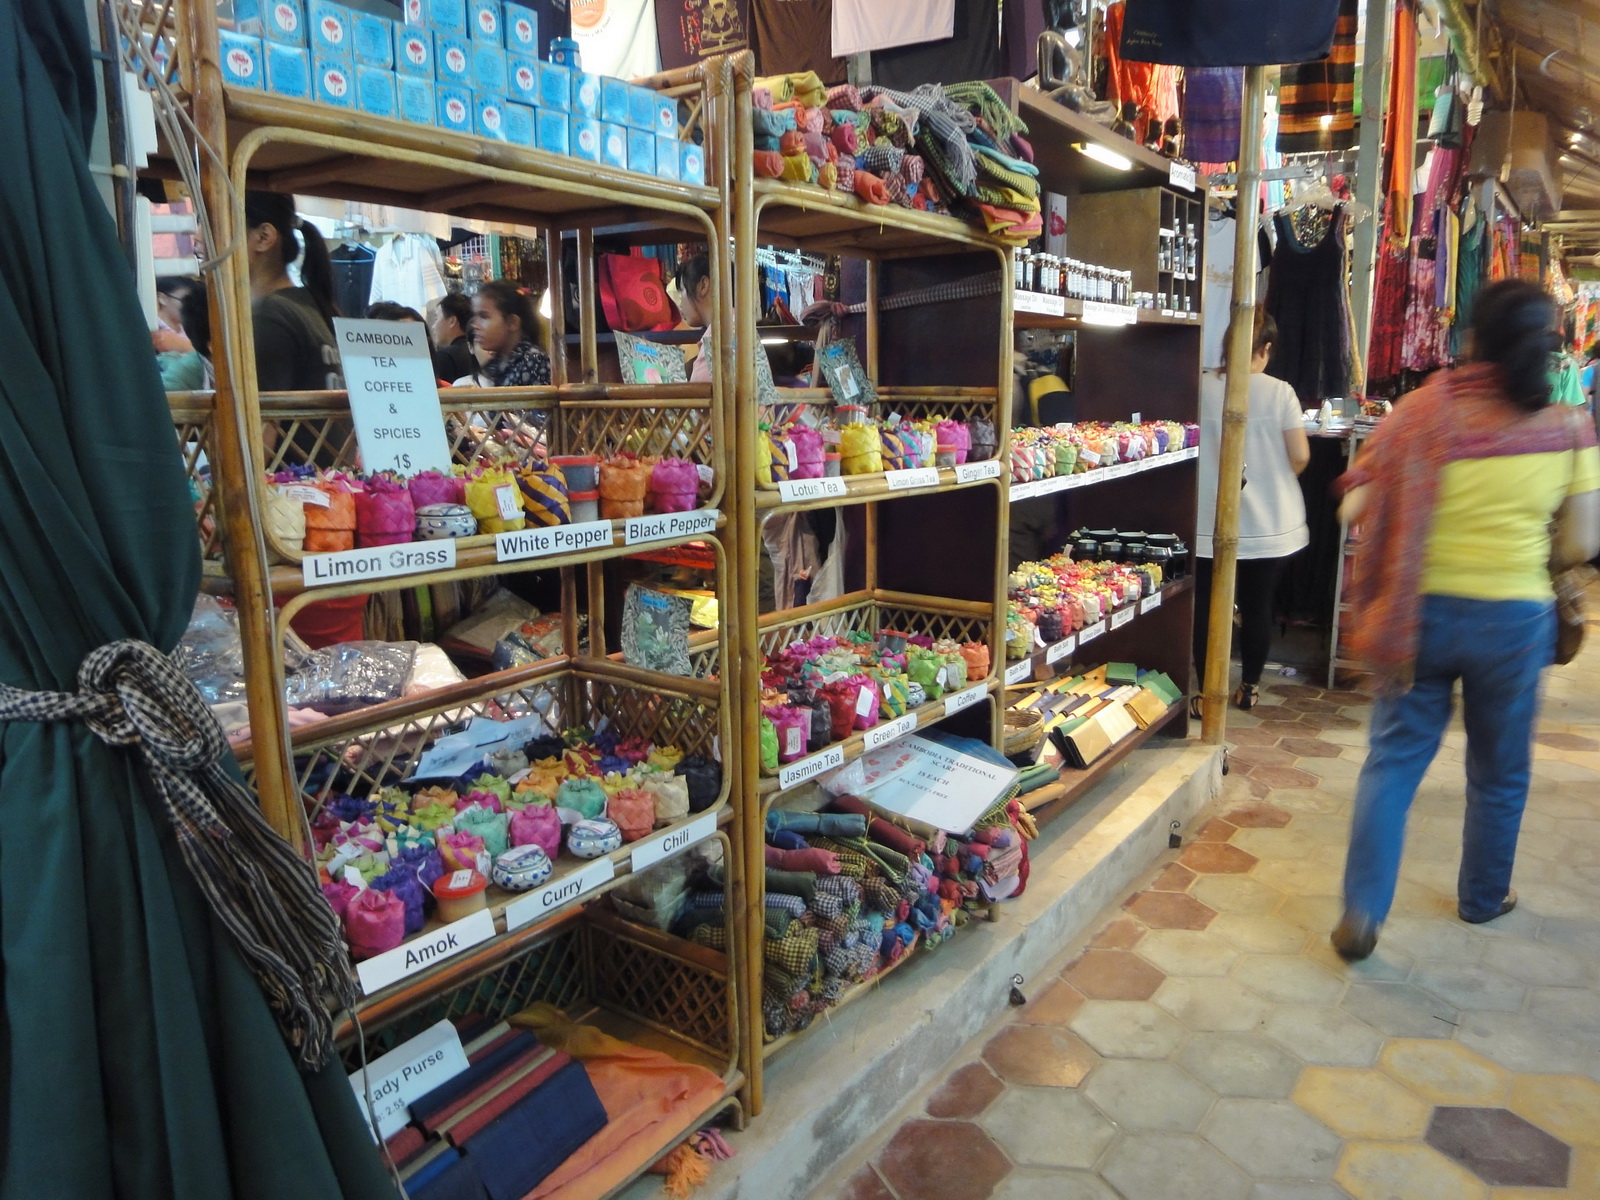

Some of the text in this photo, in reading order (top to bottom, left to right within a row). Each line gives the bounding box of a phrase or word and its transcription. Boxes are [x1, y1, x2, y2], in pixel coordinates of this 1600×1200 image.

[345, 331, 414, 347] CAMBODIA
[371, 356, 397, 368] TEA
[364, 381, 413, 393] COFFEE
[389, 403, 398, 414] &
[373, 428, 421, 440] SPICIES
[393, 453, 412, 470] 1$
[984, 465, 995, 475] Tea
[925, 475, 936, 483] Tea
[790, 481, 839, 497] Lotus Tea
[630, 517, 715, 539] Black Pepper
[501, 528, 609, 555] White Pepper
[313, 549, 448, 578] Limon Grass
[957, 692, 977, 707] Coffee
[872, 721, 910, 745] Green Tea
[784, 753, 840, 784] Jasmine Tea
[901, 740, 997, 781] CAMBODIA TRADITIONAL
[931, 760, 957, 773] SCARF
[926, 773, 950, 786] EACH
[932, 790, 948, 799] FREE
[663, 829, 689, 853] Chili
[542, 877, 584, 908] Curry
[404, 932, 459, 969] Amok
[402, 1050, 444, 1081] Purse
